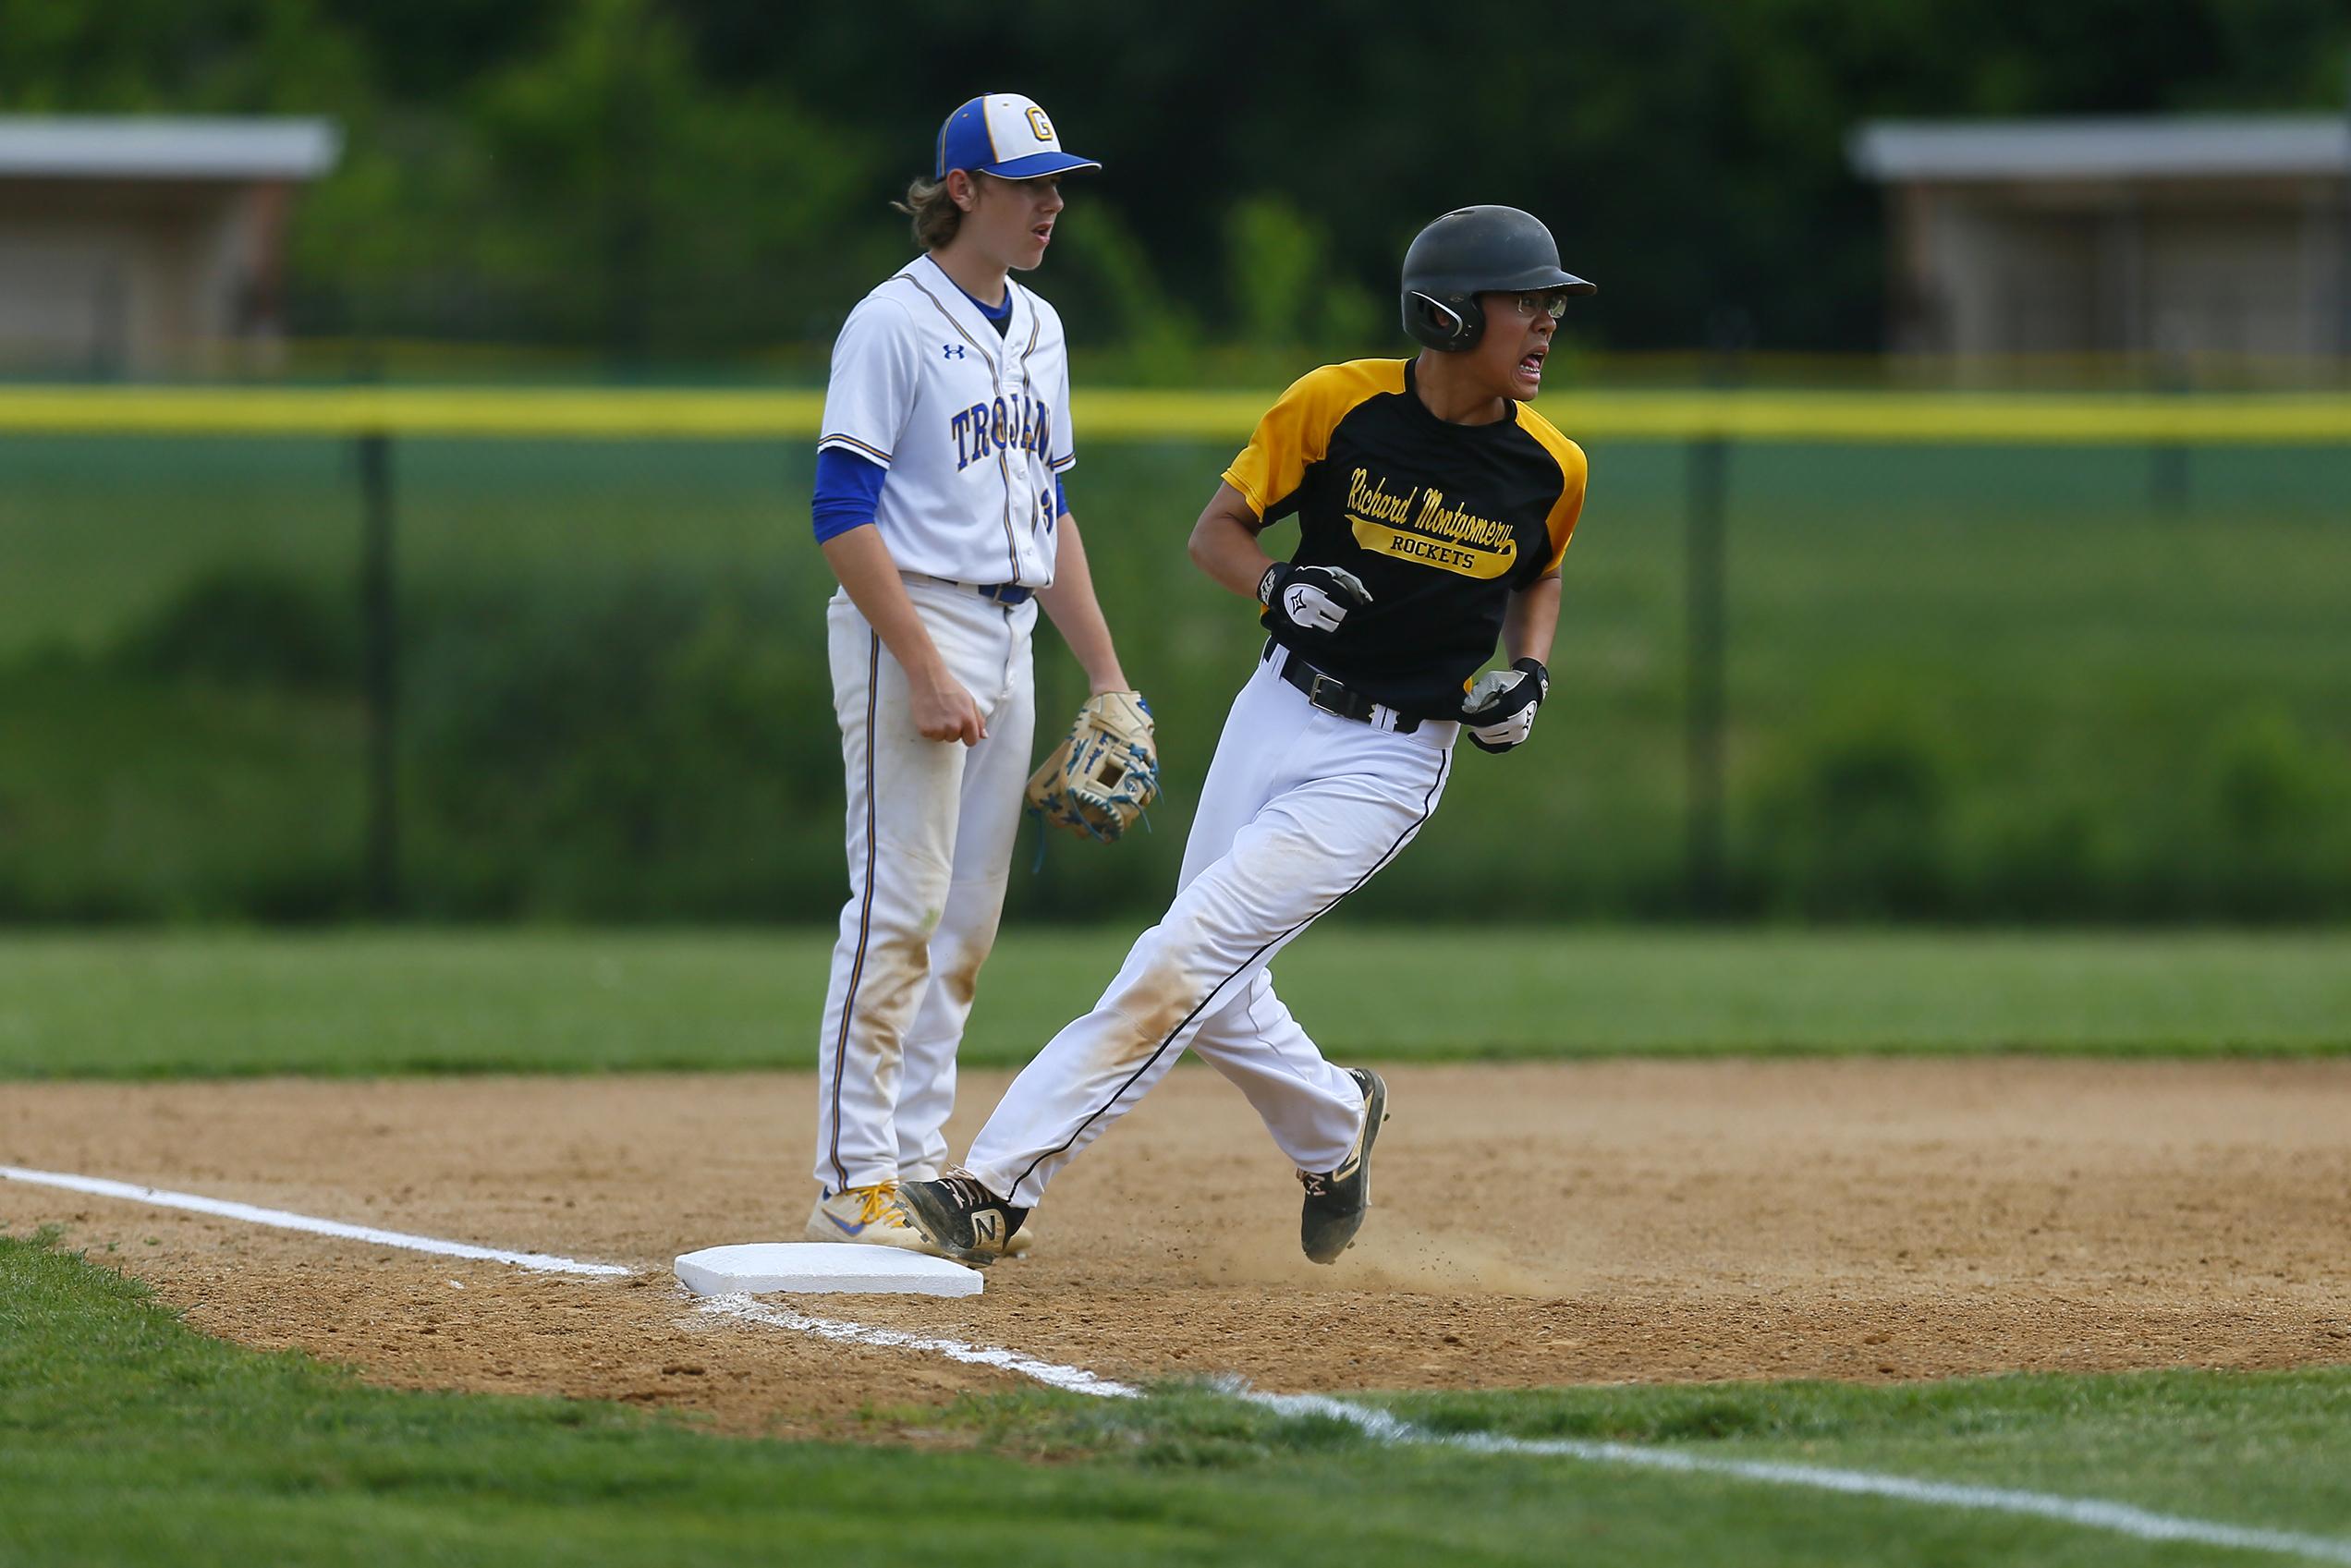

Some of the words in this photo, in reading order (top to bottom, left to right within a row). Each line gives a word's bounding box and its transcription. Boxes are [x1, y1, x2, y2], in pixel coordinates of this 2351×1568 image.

[1025, 106, 1054, 141] G
[951, 393, 1054, 473] TROJAN
[1346, 468, 1418, 525] Richard
[1414, 487, 1514, 553] Montgomery
[1390, 535, 1476, 569] ROCKETS
